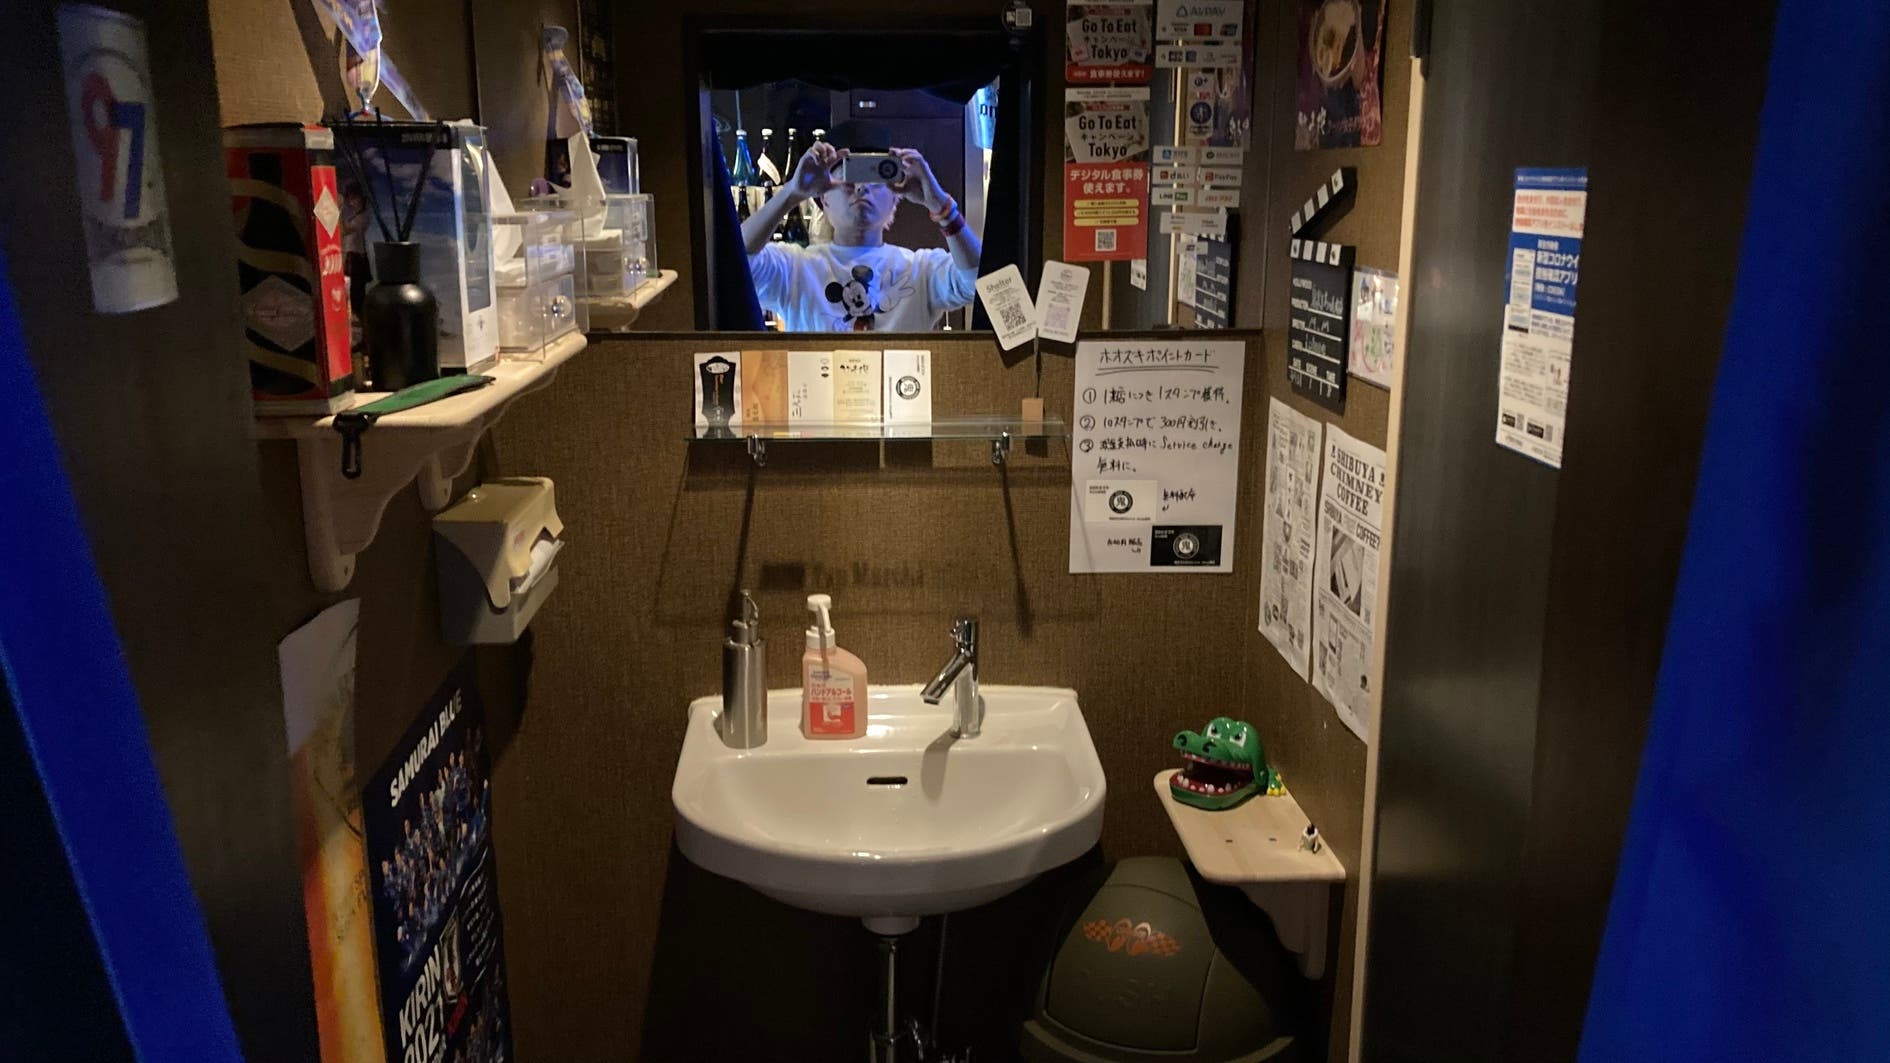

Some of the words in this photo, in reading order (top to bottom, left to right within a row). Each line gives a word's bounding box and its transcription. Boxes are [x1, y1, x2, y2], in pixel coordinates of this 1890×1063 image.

[1082, 19, 1098, 33] Go
[1100, 19, 1114, 33] To
[1116, 19, 1137, 33] Eat
[1091, 45, 1128, 62] Tokyo
[1078, 115, 1095, 130] Go
[1098, 115, 1113, 130] To
[1115, 115, 1137, 130] Eat
[1088, 142, 1128, 160] Tokyo
[985, 276, 1013, 294] Shelter
[1337, 448, 1376, 484] SHIBUYA
[1330, 464, 1384, 504] CHIMNEY
[1336, 483, 1369, 517] COFFEE
[390, 720, 439, 808] SAMURAI
[438, 688, 462, 737] BLUE
[399, 943, 442, 1049] KIRIN
